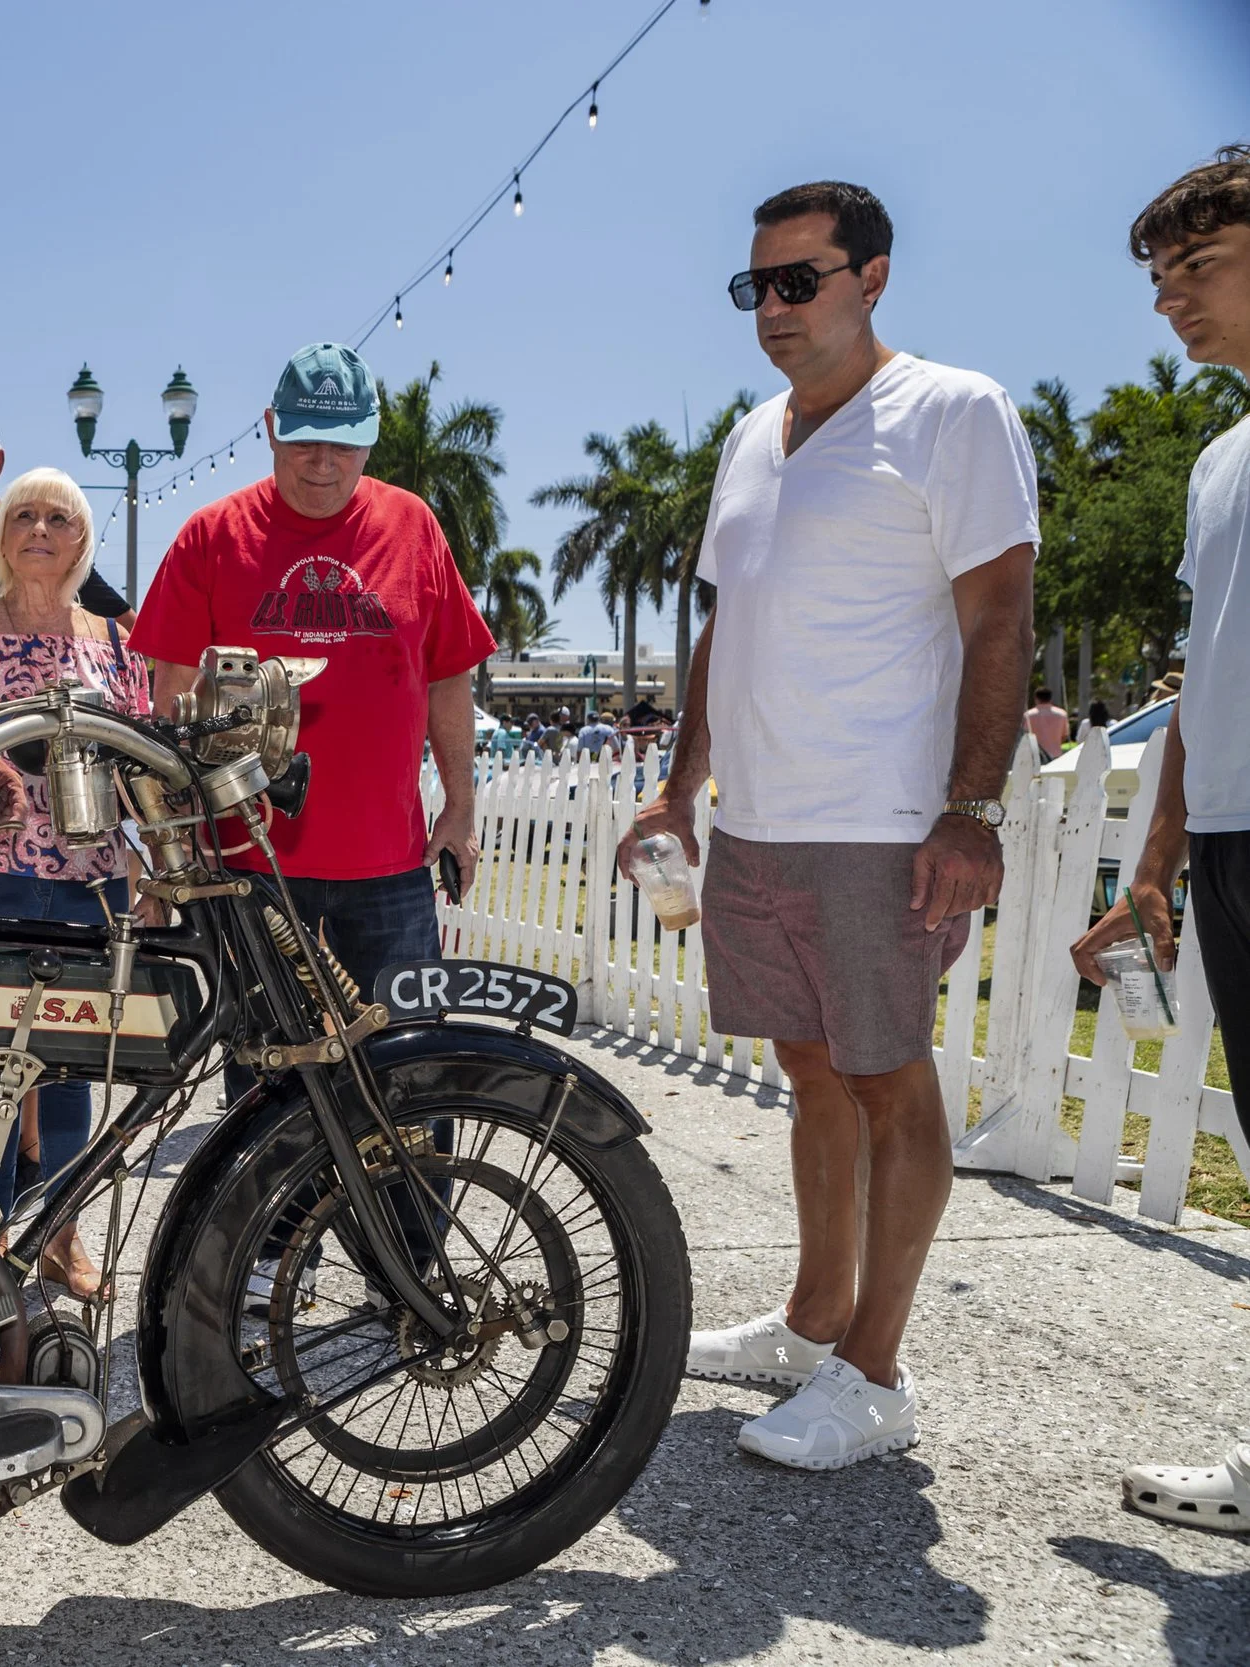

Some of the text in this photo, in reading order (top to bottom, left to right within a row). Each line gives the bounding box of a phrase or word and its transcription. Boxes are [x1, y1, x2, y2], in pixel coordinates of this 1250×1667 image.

[280, 555, 315, 589] INDIANAPOLIS
[317, 555, 340, 567] MOTOR
[293, 592, 348, 629] GRAND
[347, 592, 395, 630] PRIX
[390, 967, 569, 1028] CR 2572
